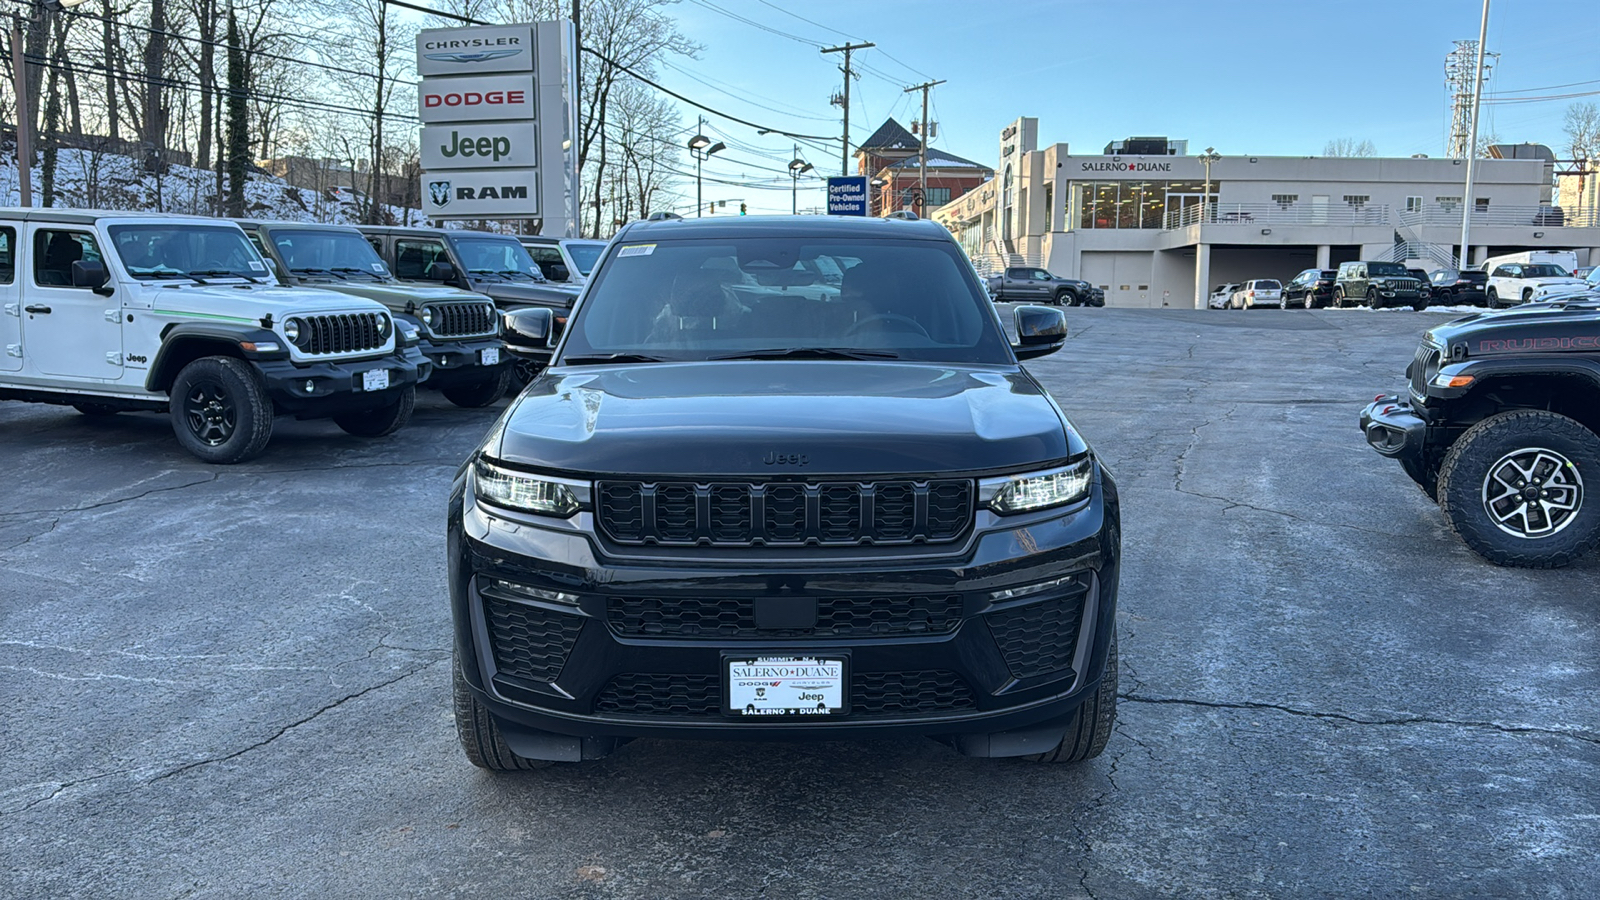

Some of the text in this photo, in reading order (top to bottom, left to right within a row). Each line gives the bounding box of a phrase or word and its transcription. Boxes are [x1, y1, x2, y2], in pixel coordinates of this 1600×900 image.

[424, 37, 520, 50] CHRYSLER
[424, 90, 525, 108] DODGE
[440, 130, 511, 162] Jeep
[1081, 162, 1171, 172] SALERNO DUANE
[456, 186, 528, 200] RAM
[829, 184, 860, 193] Certified
[829, 193, 865, 202] Pre-Owned
[829, 203, 860, 212] Vehicles
[126, 352, 148, 364] Jeep
[762, 451, 810, 467] Jeep
[733, 667, 839, 678] SALERNO DUANE
[798, 692, 825, 702] Jeep
[741, 708, 786, 716] SALERNO
